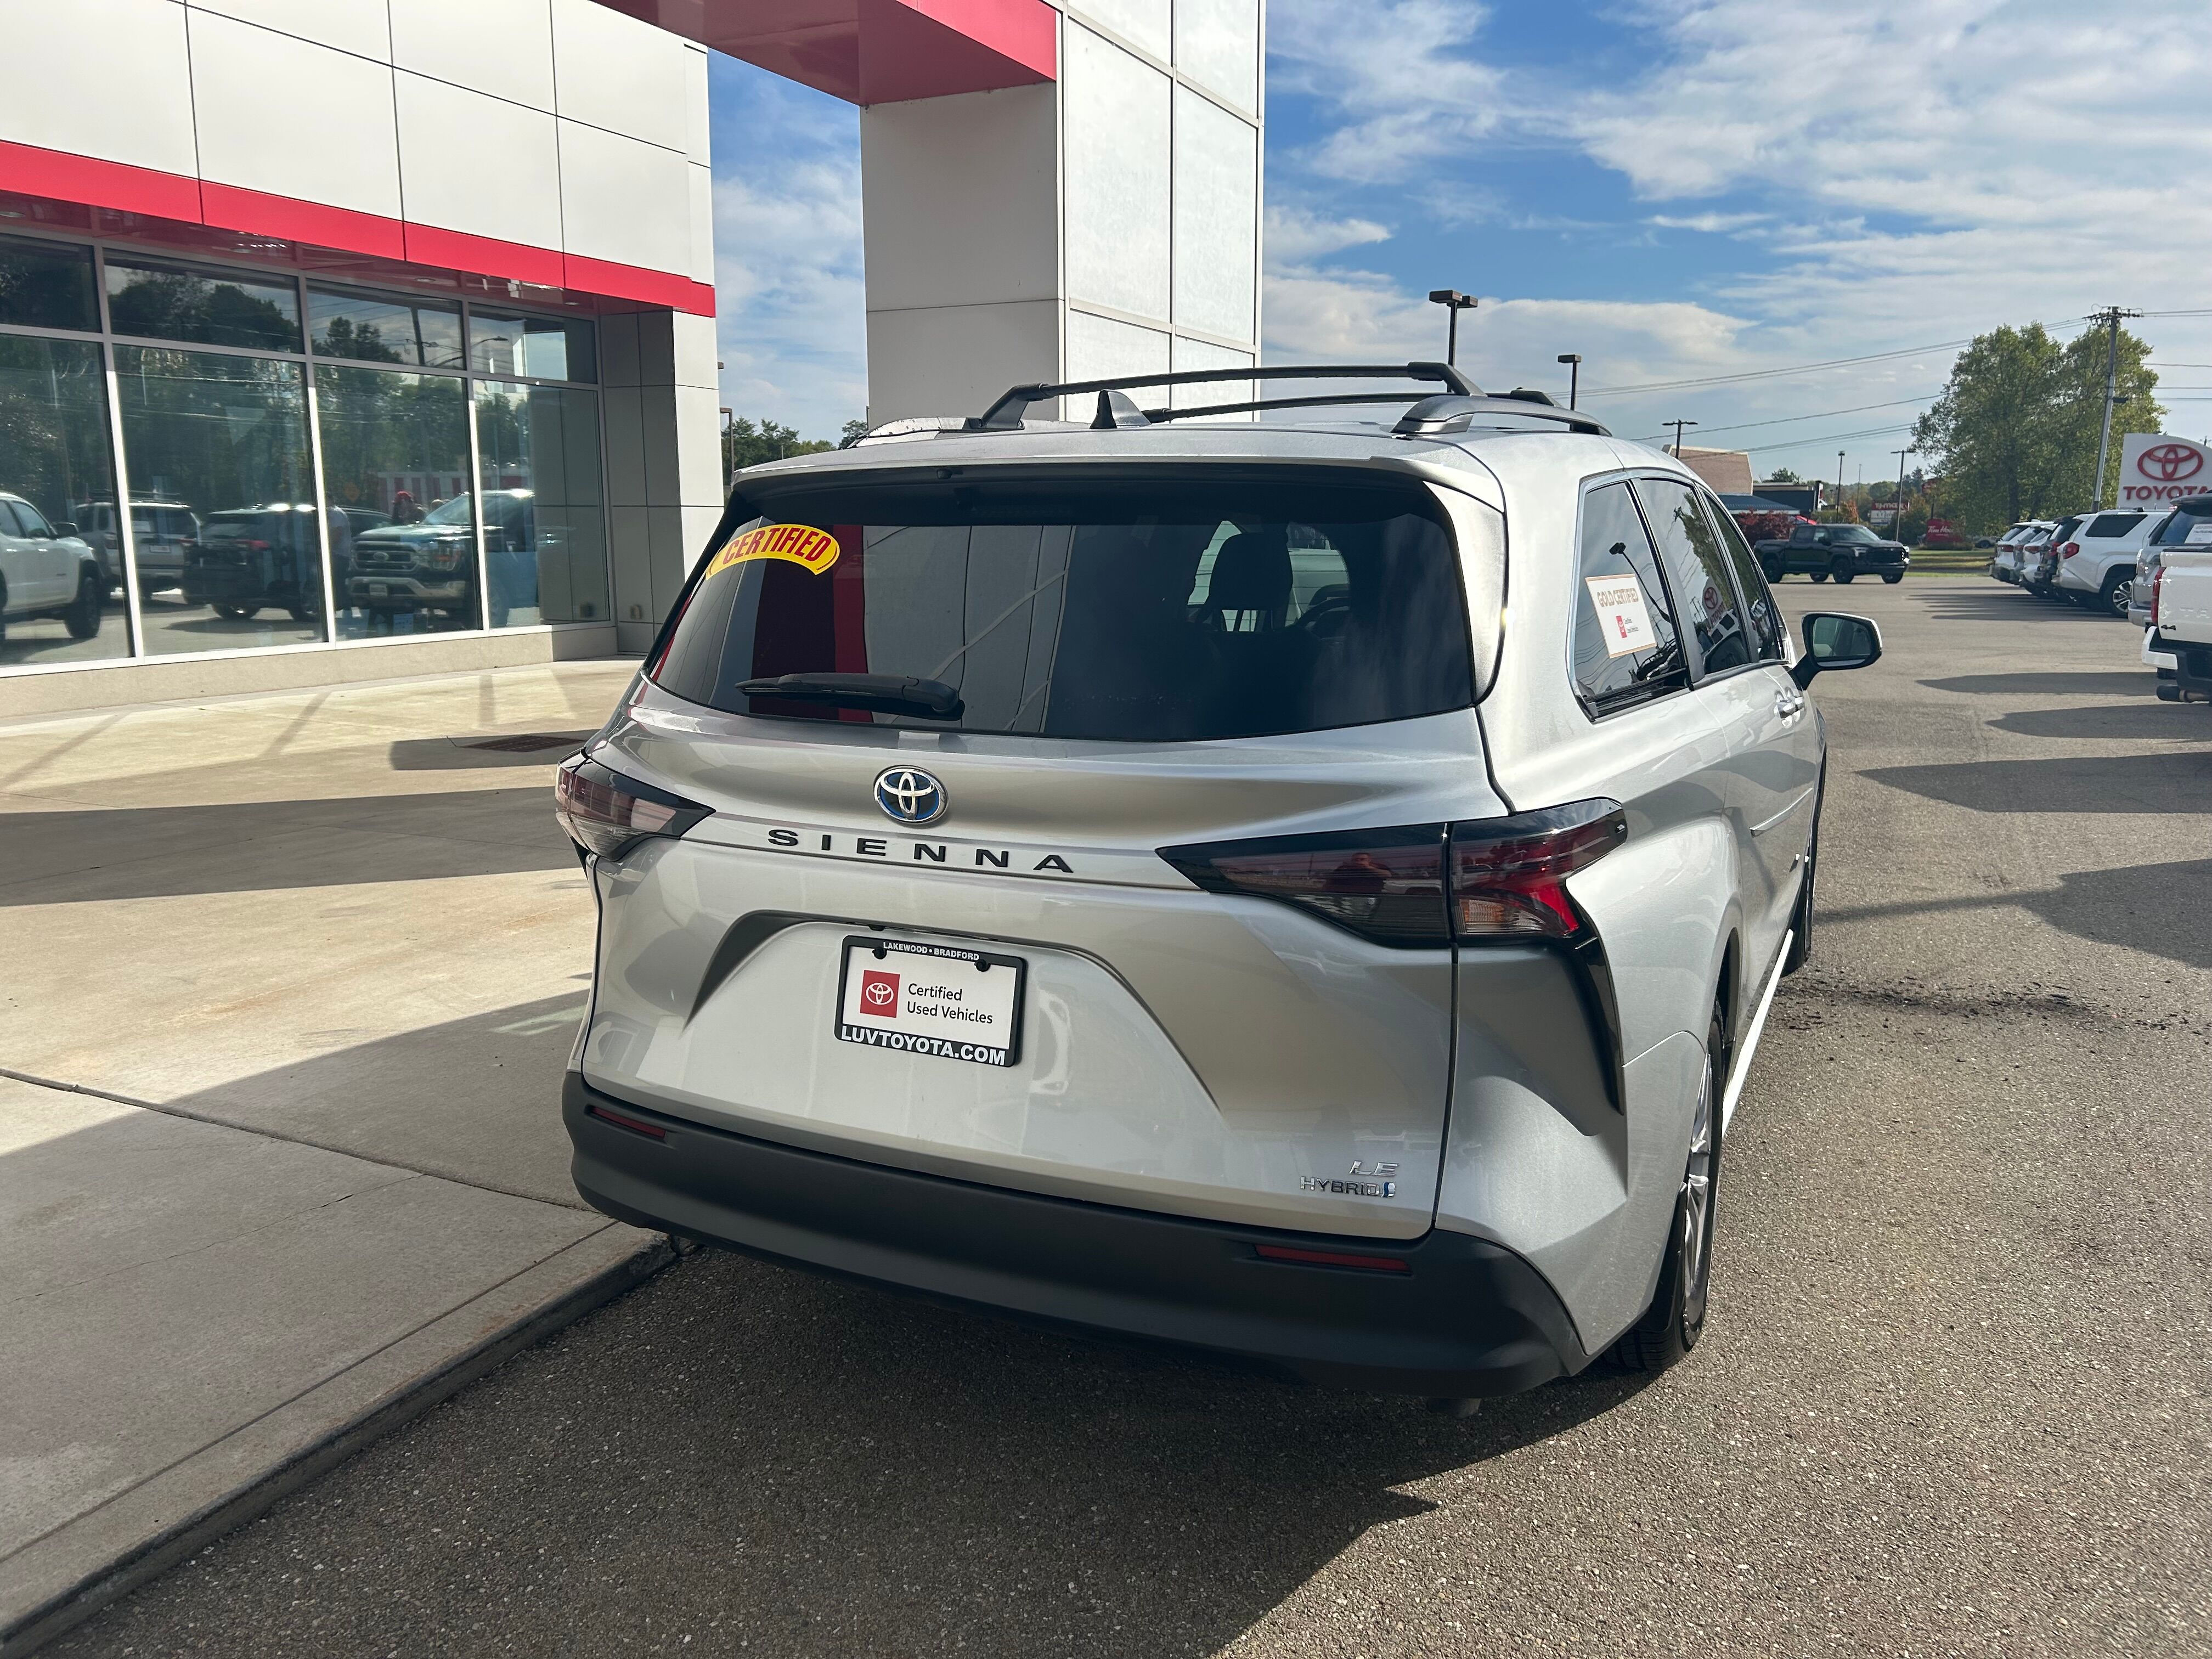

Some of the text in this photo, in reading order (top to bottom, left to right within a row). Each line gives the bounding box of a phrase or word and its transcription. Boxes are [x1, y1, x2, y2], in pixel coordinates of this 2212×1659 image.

[723, 527, 831, 565] CERTIFIED
[768, 829, 1074, 873] SIENNA
[883, 941, 979, 961] LAKEWOOD BRADFORD
[908, 983, 962, 1001] Certified
[907, 1001, 993, 1024] Used Vehicles
[841, 1025, 1006, 1066] LUVTOYOTA.COM
[1348, 1160, 1400, 1177] LE
[1300, 1176, 1380, 1196] HYBRID
